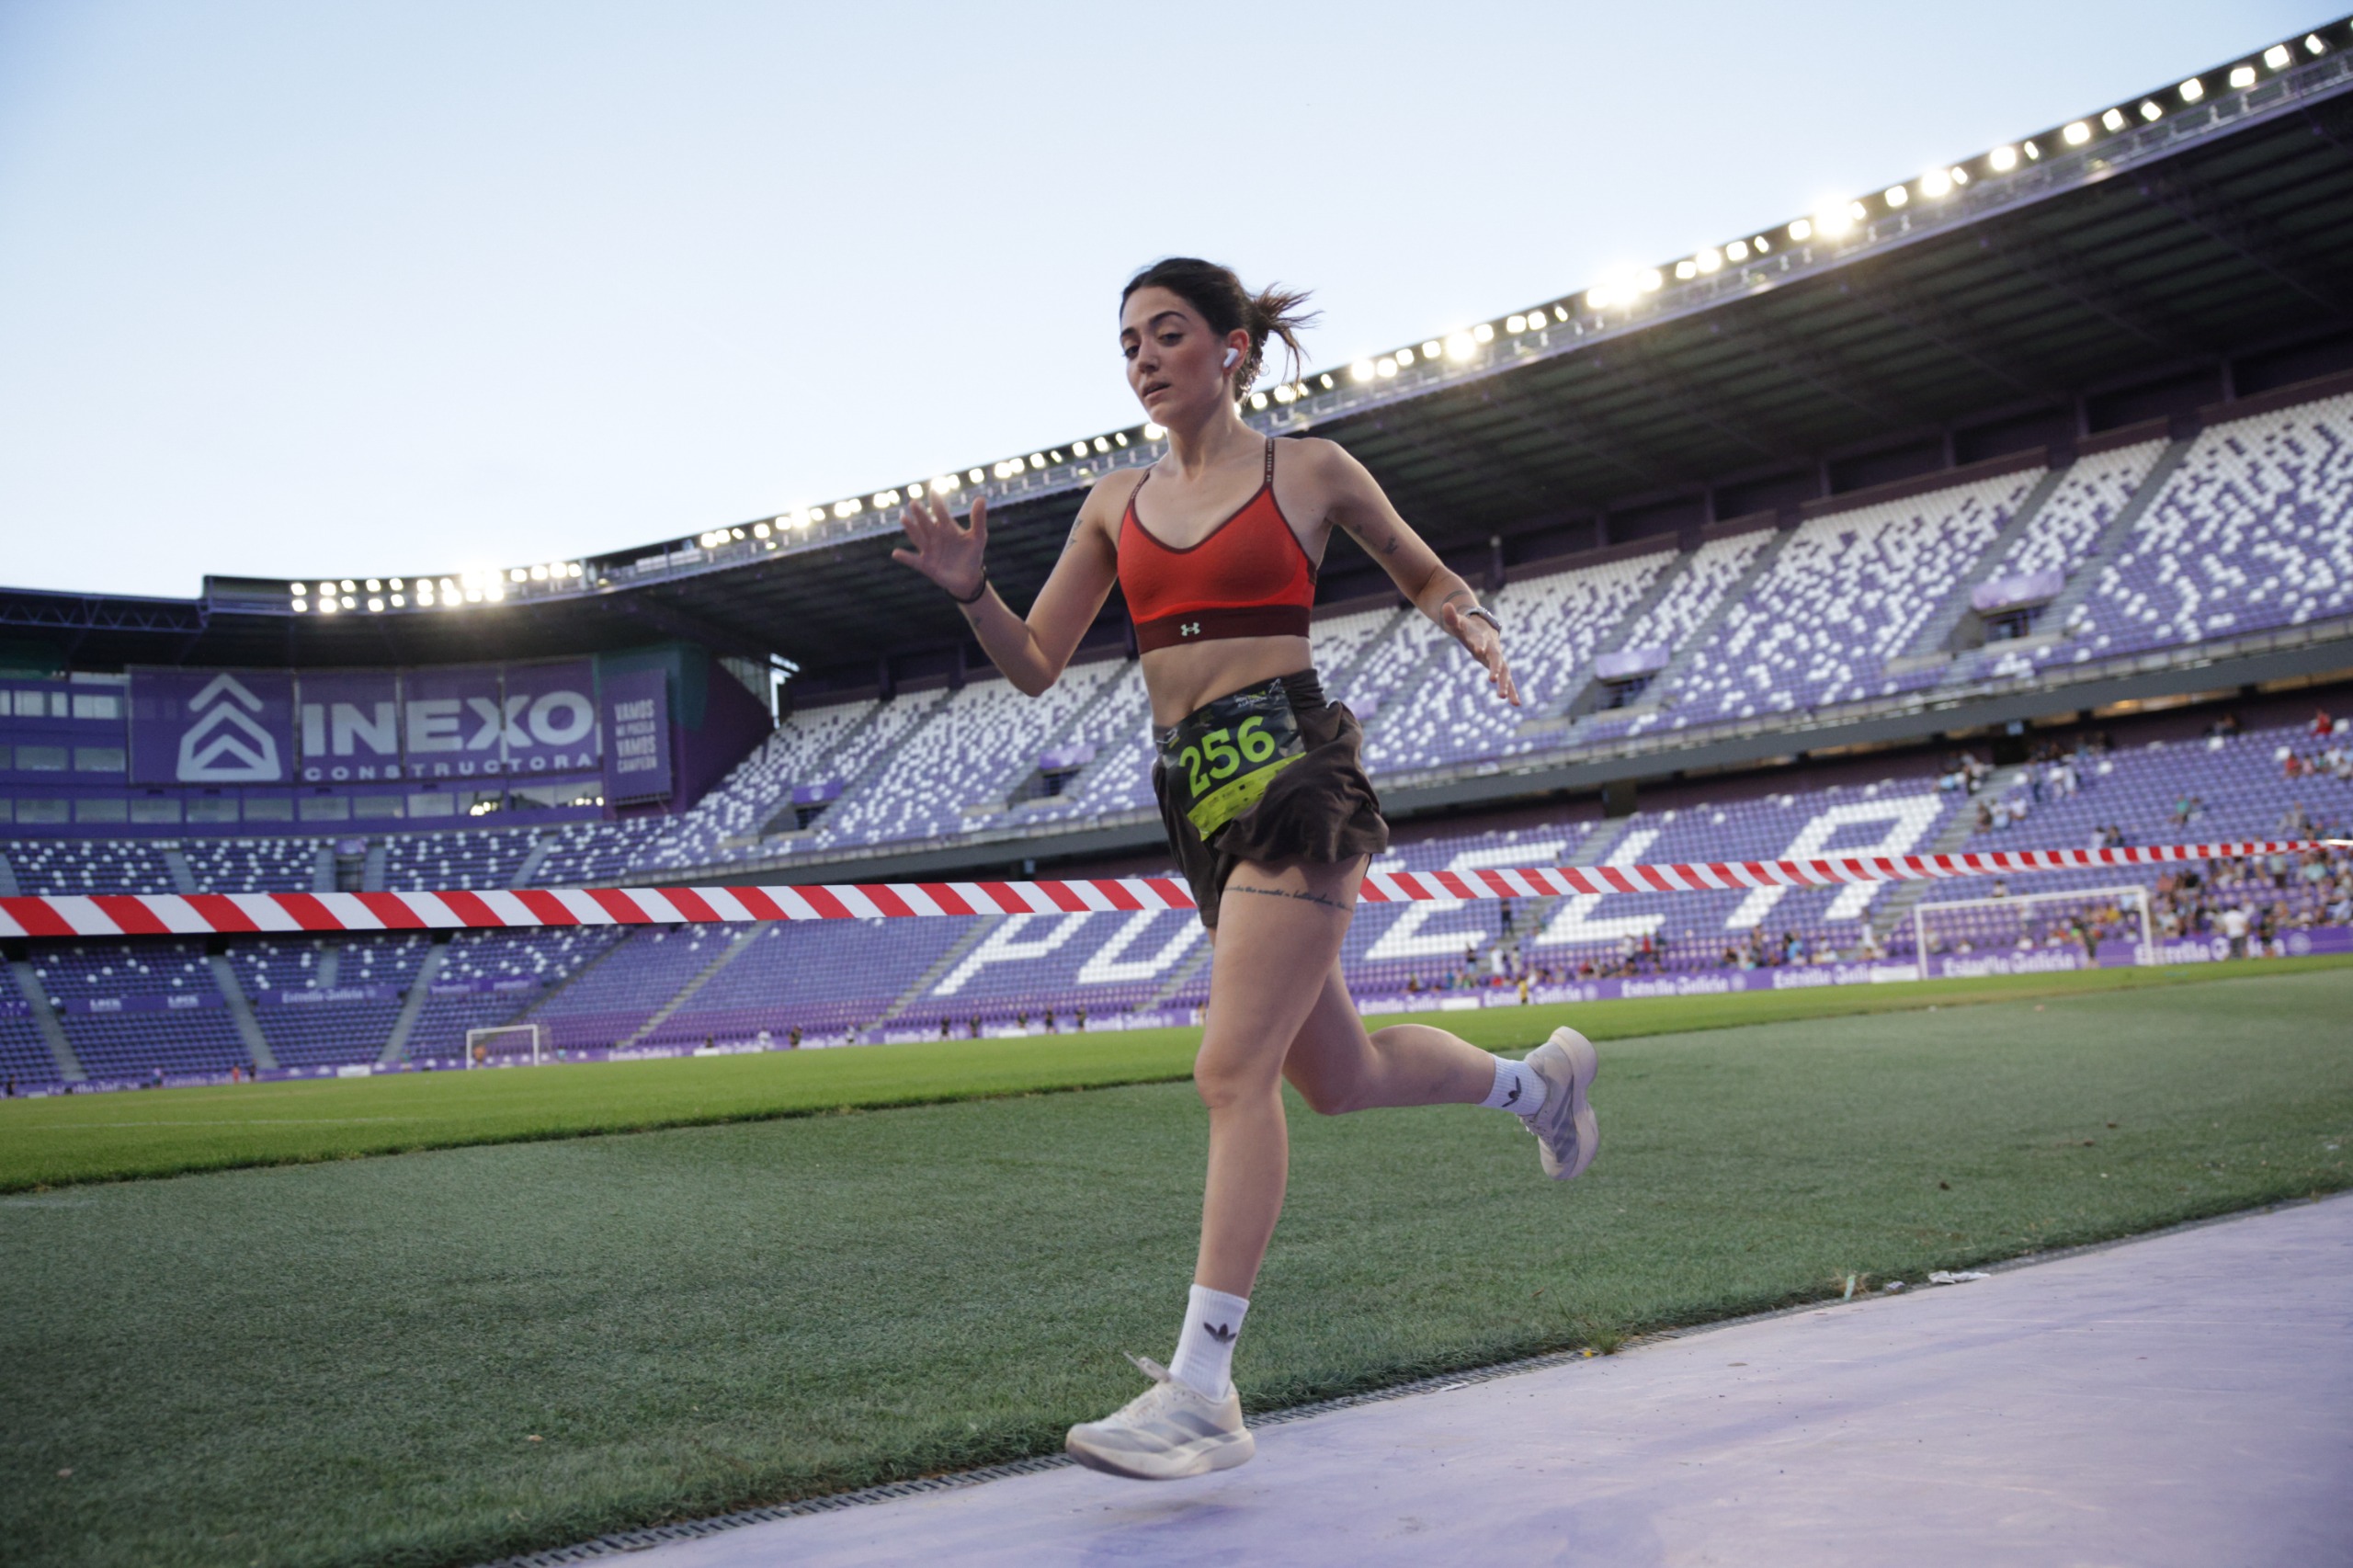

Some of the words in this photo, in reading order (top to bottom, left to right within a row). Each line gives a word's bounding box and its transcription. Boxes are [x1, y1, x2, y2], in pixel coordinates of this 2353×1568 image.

[301, 690, 595, 756] INEXO
[303, 752, 593, 781] CONSTRUCTORA
[1179, 715, 1276, 799] 256
